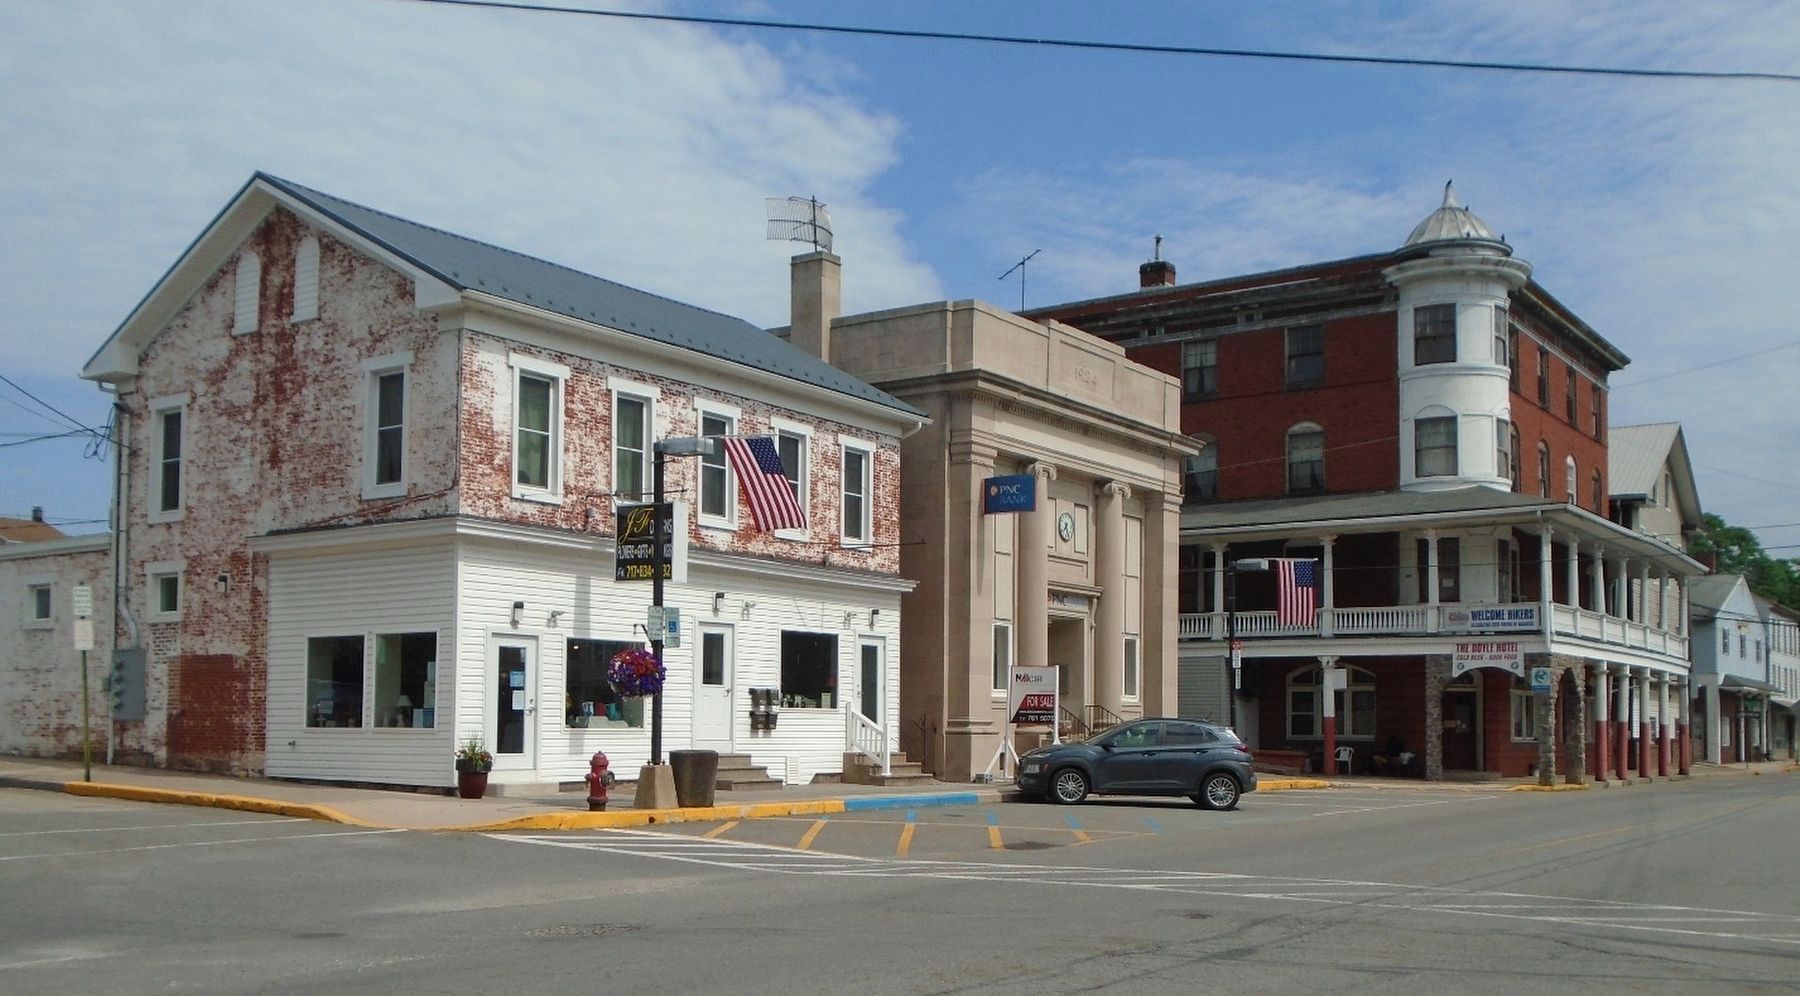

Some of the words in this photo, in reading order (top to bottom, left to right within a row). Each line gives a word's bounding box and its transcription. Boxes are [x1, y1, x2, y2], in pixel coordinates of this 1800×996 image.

[999, 483, 1021, 494] PNC
[999, 494, 1027, 505] BANK
[1471, 609, 1505, 621] WELCOME
[1508, 608, 1535, 620] HIKERS
[1456, 643, 1469, 653] THE
[1471, 642, 1494, 653] DOYLE
[1496, 641, 1519, 652] HOTEL
[1026, 696, 1038, 707] FOR
[1040, 696, 1054, 707] SALE
